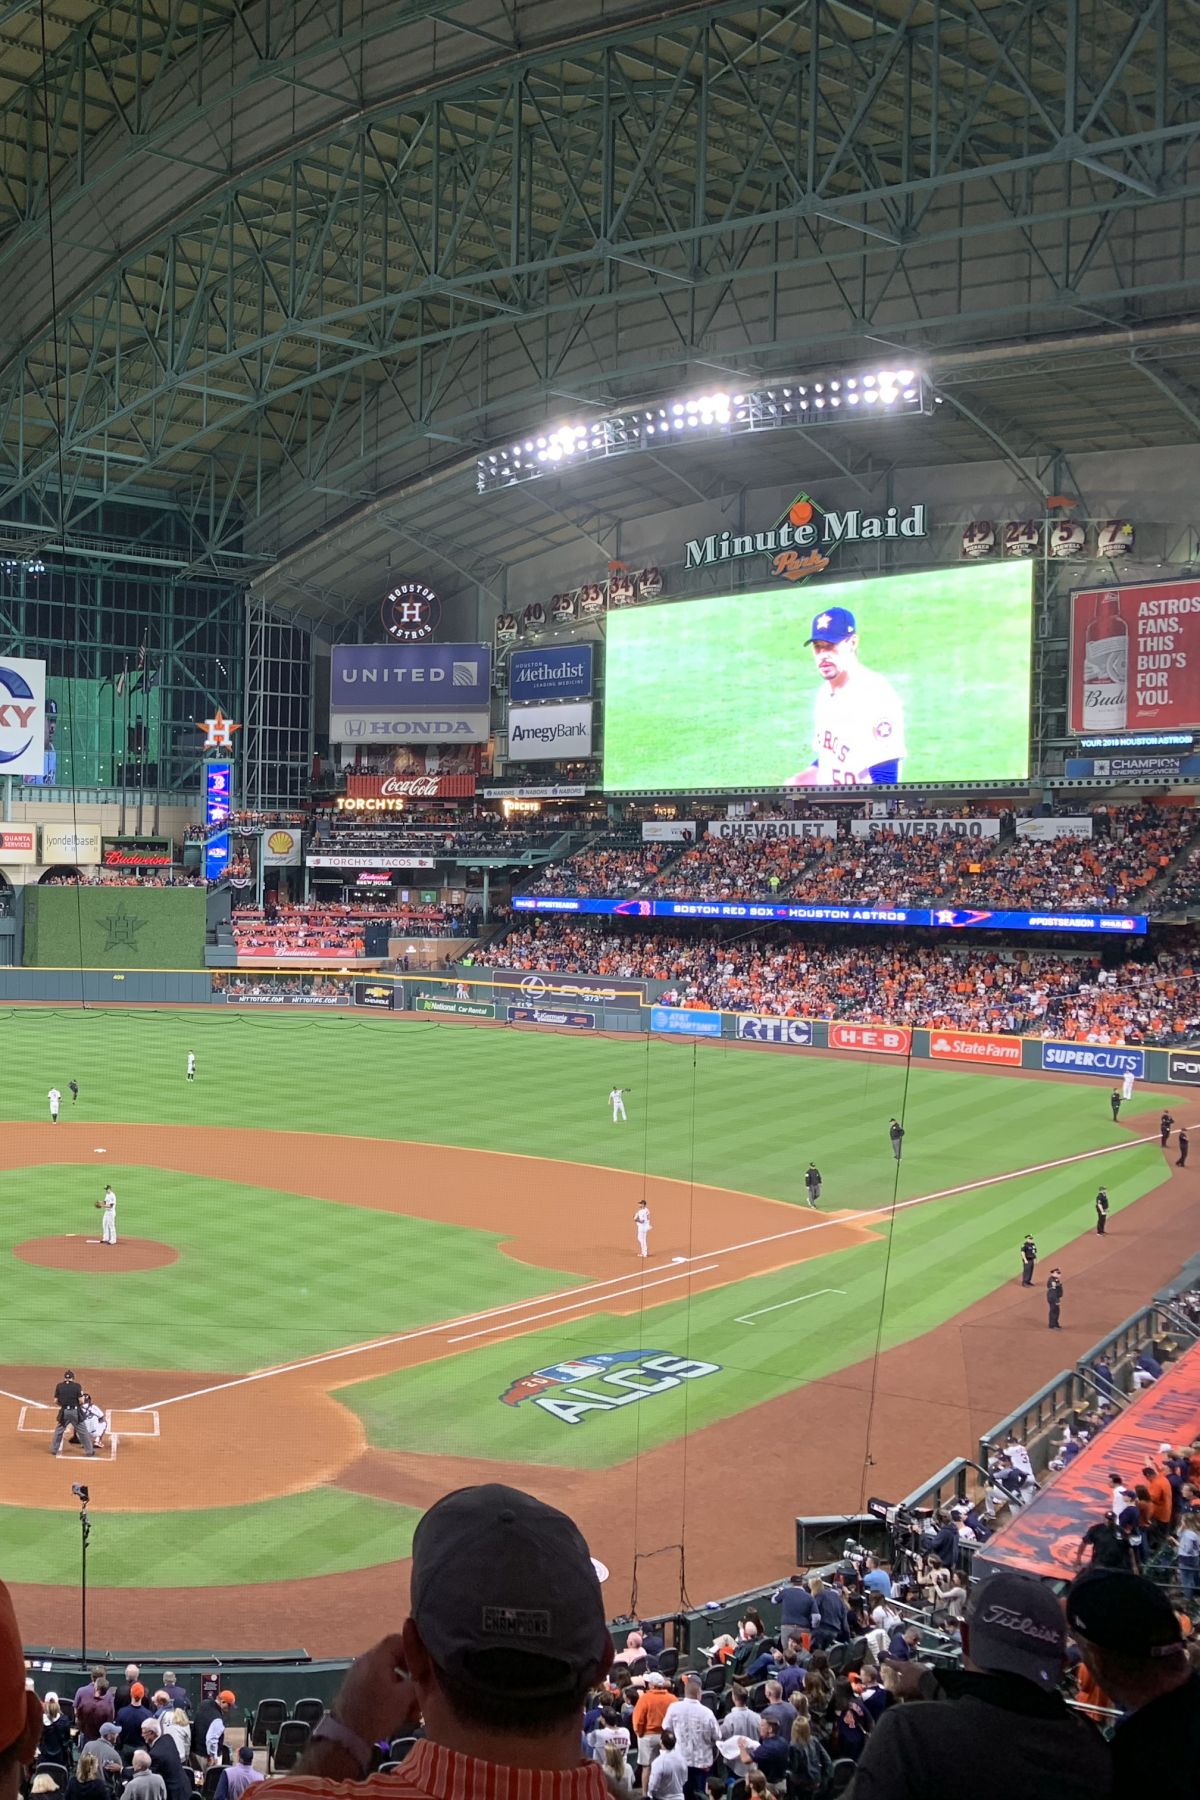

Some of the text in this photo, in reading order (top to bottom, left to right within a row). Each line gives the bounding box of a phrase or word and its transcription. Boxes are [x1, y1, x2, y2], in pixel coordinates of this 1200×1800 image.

[684, 505, 925, 568] Minute Maid
[962, 521, 991, 543] 49
[1006, 520, 1035, 542] 24
[1059, 519, 1073, 542] 5
[1106, 519, 1124, 542] 7
[388, 584, 435, 602] HOUSTON
[581, 584, 600, 602] 33
[610, 576, 630, 594] 34
[552, 594, 571, 611] 25
[524, 603, 542, 620] 40
[497, 614, 514, 631] 32
[1138, 617, 1184, 635] FANS,
[389, 624, 432, 640] ASTROS
[1138, 635, 1174, 652] THIS
[1137, 652, 1186, 670] BUD'S
[342, 668, 445, 683] UNITED
[515, 663, 584, 682] Methodist
[1137, 672, 1168, 688] FOR
[1136, 690, 1173, 706] YOU.
[370, 721, 475, 735] HONDA
[512, 722, 586, 742] AmegyBank
[1120, 737, 1157, 745] HOUSTON
[1112, 758, 1180, 769] CHAMPION
[381, 776, 442, 797] Coca-Cola
[337, 799, 404, 811] TORCHYS
[4, 833, 31, 841] QUANTA
[4, 841, 31, 849] SERVICES
[104, 850, 172, 865] Budweiser
[328, 858, 412, 867] TORCHYS TACOS
[674, 905, 719, 915] BOSTON
[723, 906, 746, 915] RED
[750, 907, 773, 916] SOX
[789, 910, 848, 919] HOUSTON
[853, 911, 906, 921] ASTROS
[1029, 918, 1094, 928] #POSTSEASON
[274, 947, 320, 957] Budweiser
[431, 1001, 456, 1011] National
[739, 1016, 811, 1043] RTIC
[1046, 1048, 1137, 1070] SUPERCUTS
[1173, 1062, 1200, 1073] PO
[533, 1356, 721, 1424] ALCS
[982, 1605, 1060, 1644] Titleist
